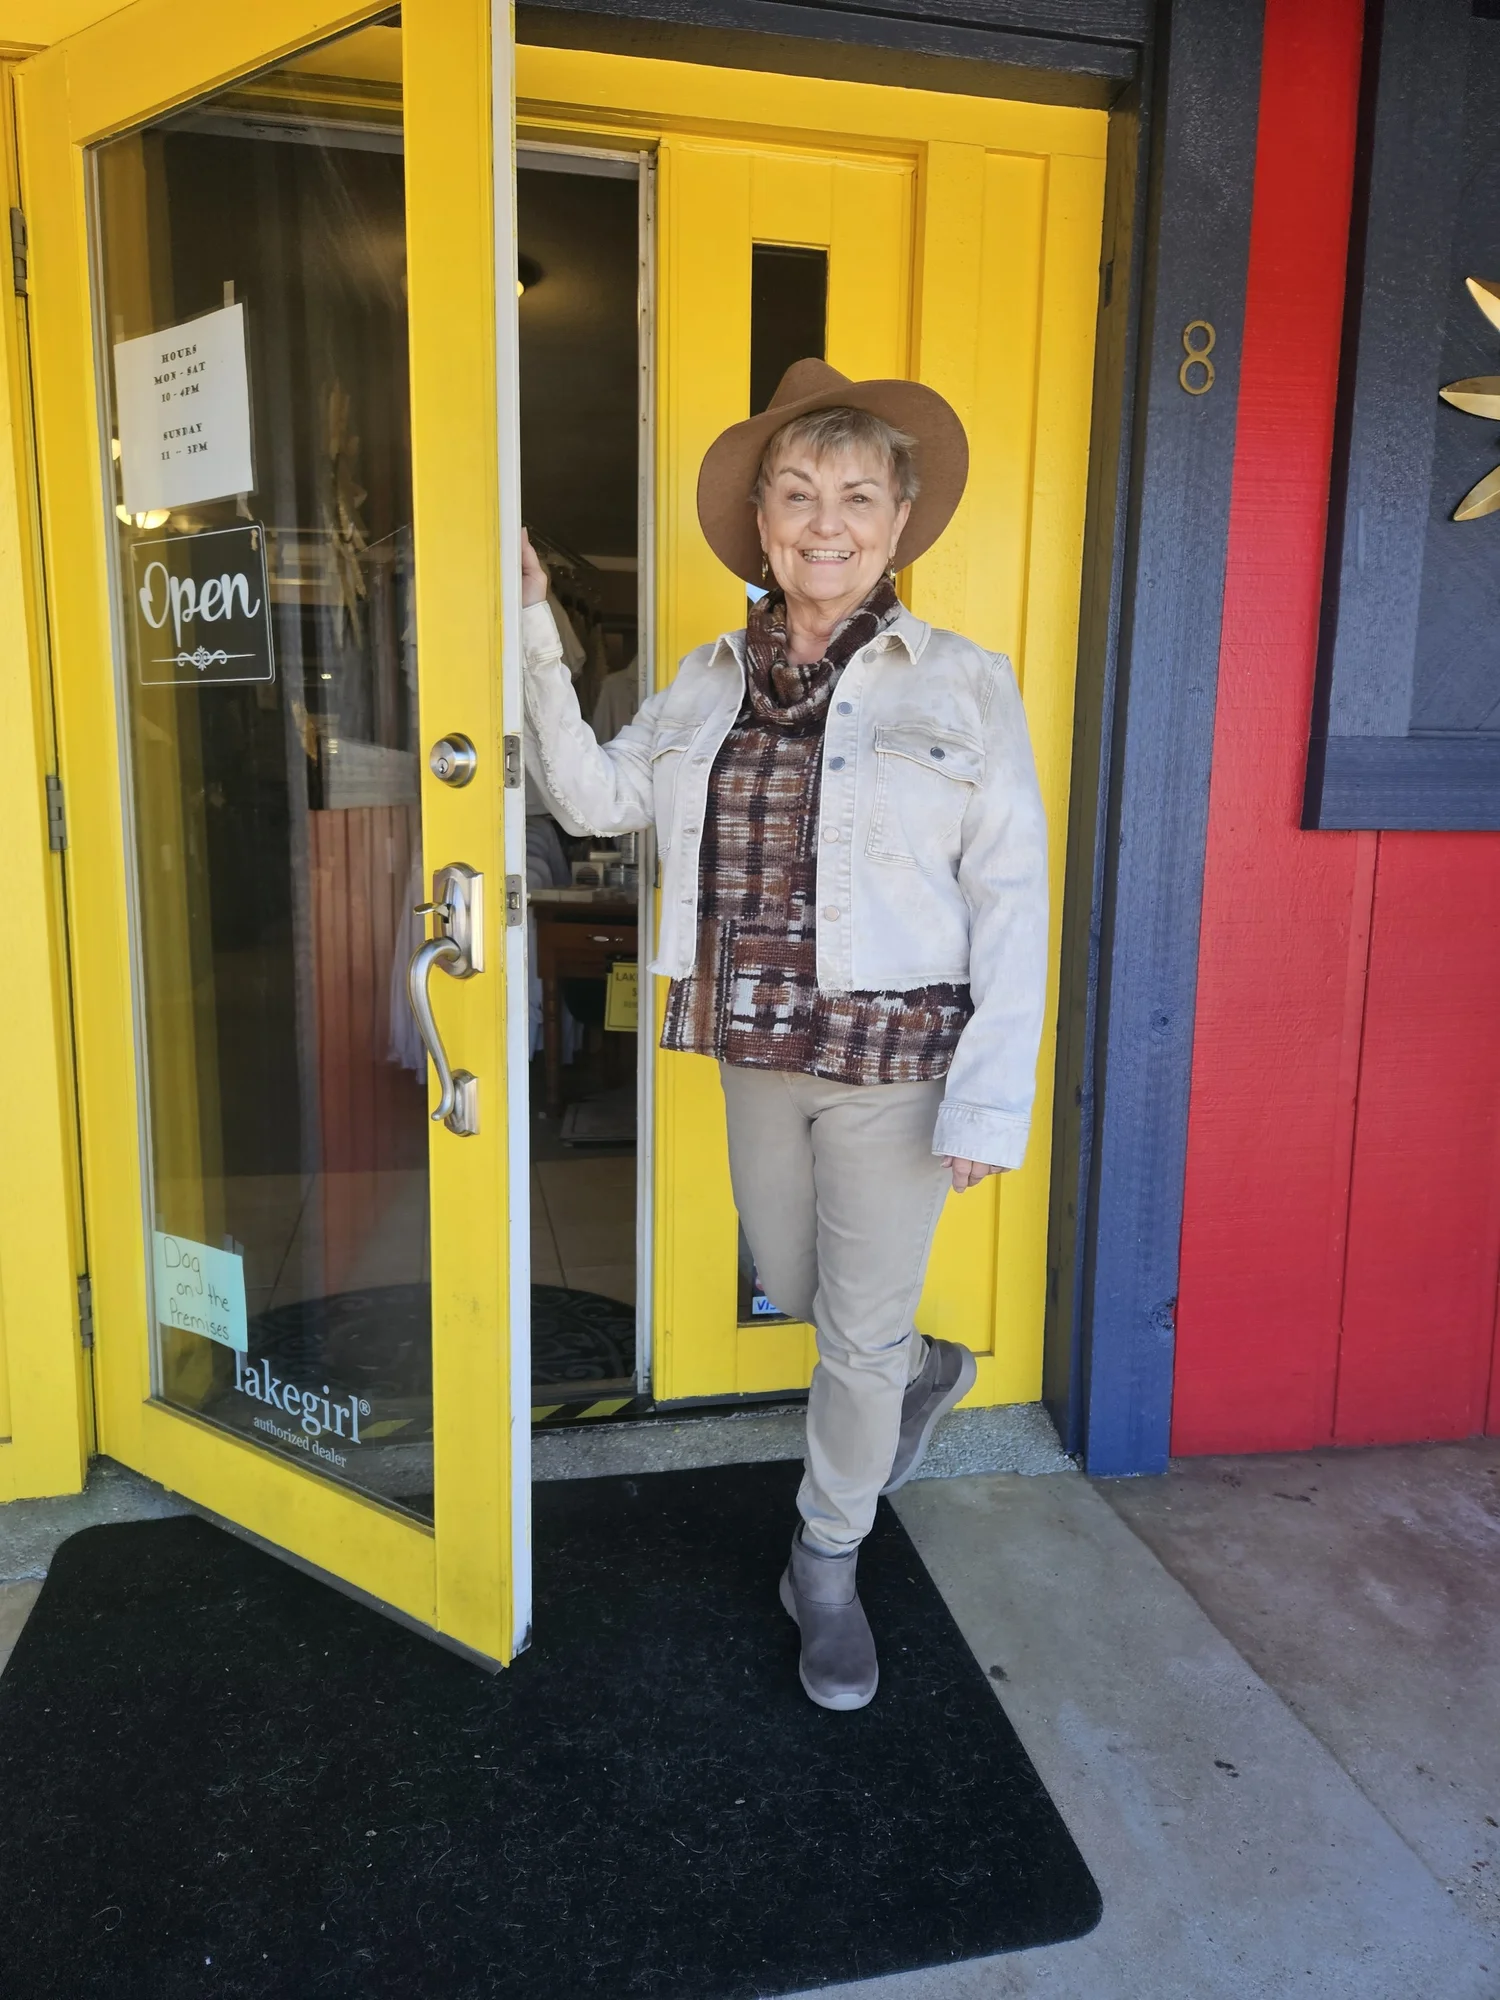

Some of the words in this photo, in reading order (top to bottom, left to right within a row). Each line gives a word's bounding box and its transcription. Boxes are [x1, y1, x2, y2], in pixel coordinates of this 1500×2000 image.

[161, 344, 197, 364] HOURS
[1180, 320, 1216, 395] 8
[153, 371, 176, 385] MON
[186, 361, 206, 376] SAT
[161, 392, 171, 402] 10
[180, 383, 200, 397] 4PM
[163, 422, 202, 441] SUNDAY
[161, 451, 170, 460] 11
[187, 441, 208, 454] 3PM
[139, 561, 261, 648] Open
[616, 971, 638, 981] LAK
[164, 1236, 203, 1296] Dog
[177, 1283, 194, 1298] on
[208, 1283, 230, 1312] the
[169, 1297, 230, 1341] Premises
[253, 1415, 310, 1451] authorized
[312, 1440, 347, 1468] dealer
